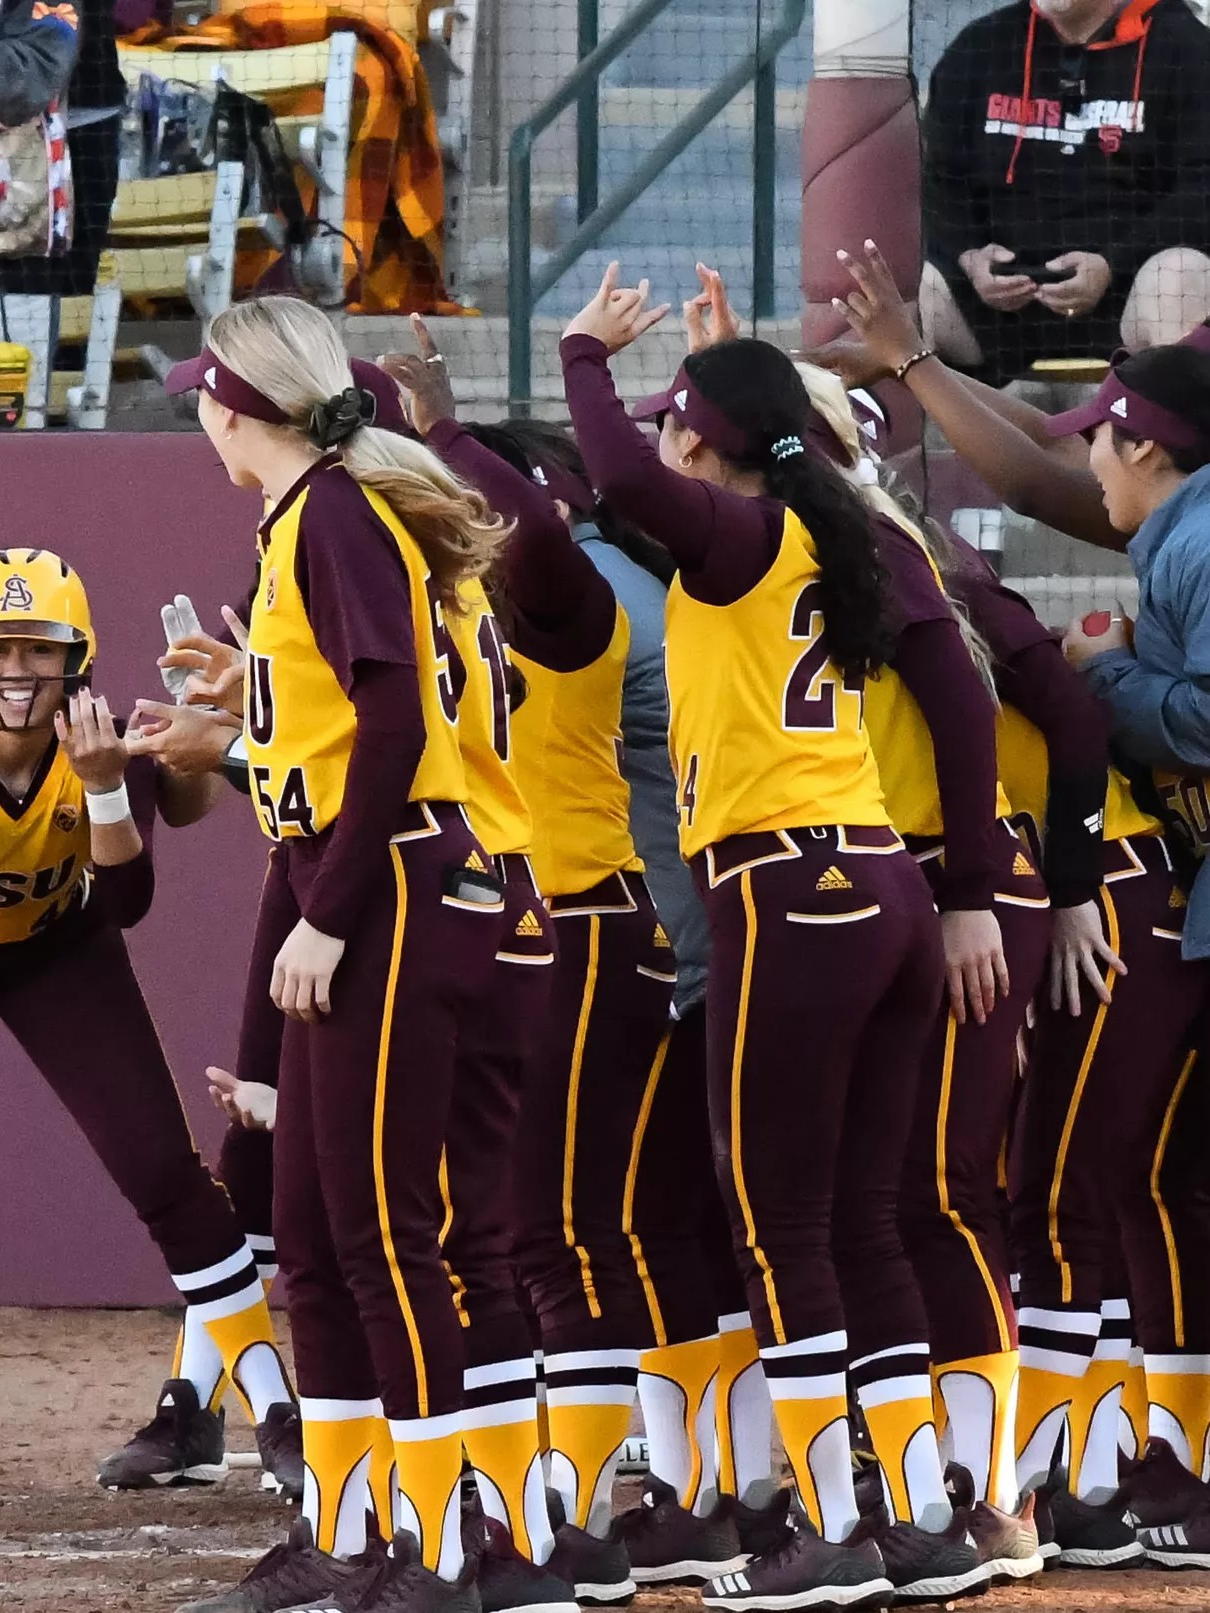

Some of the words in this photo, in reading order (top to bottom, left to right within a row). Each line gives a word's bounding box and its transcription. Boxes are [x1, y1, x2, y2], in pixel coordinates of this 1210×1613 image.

[987, 93, 1062, 127] GIANTS
[252, 764, 319, 842] 54
[815, 881, 853, 891] adidas
